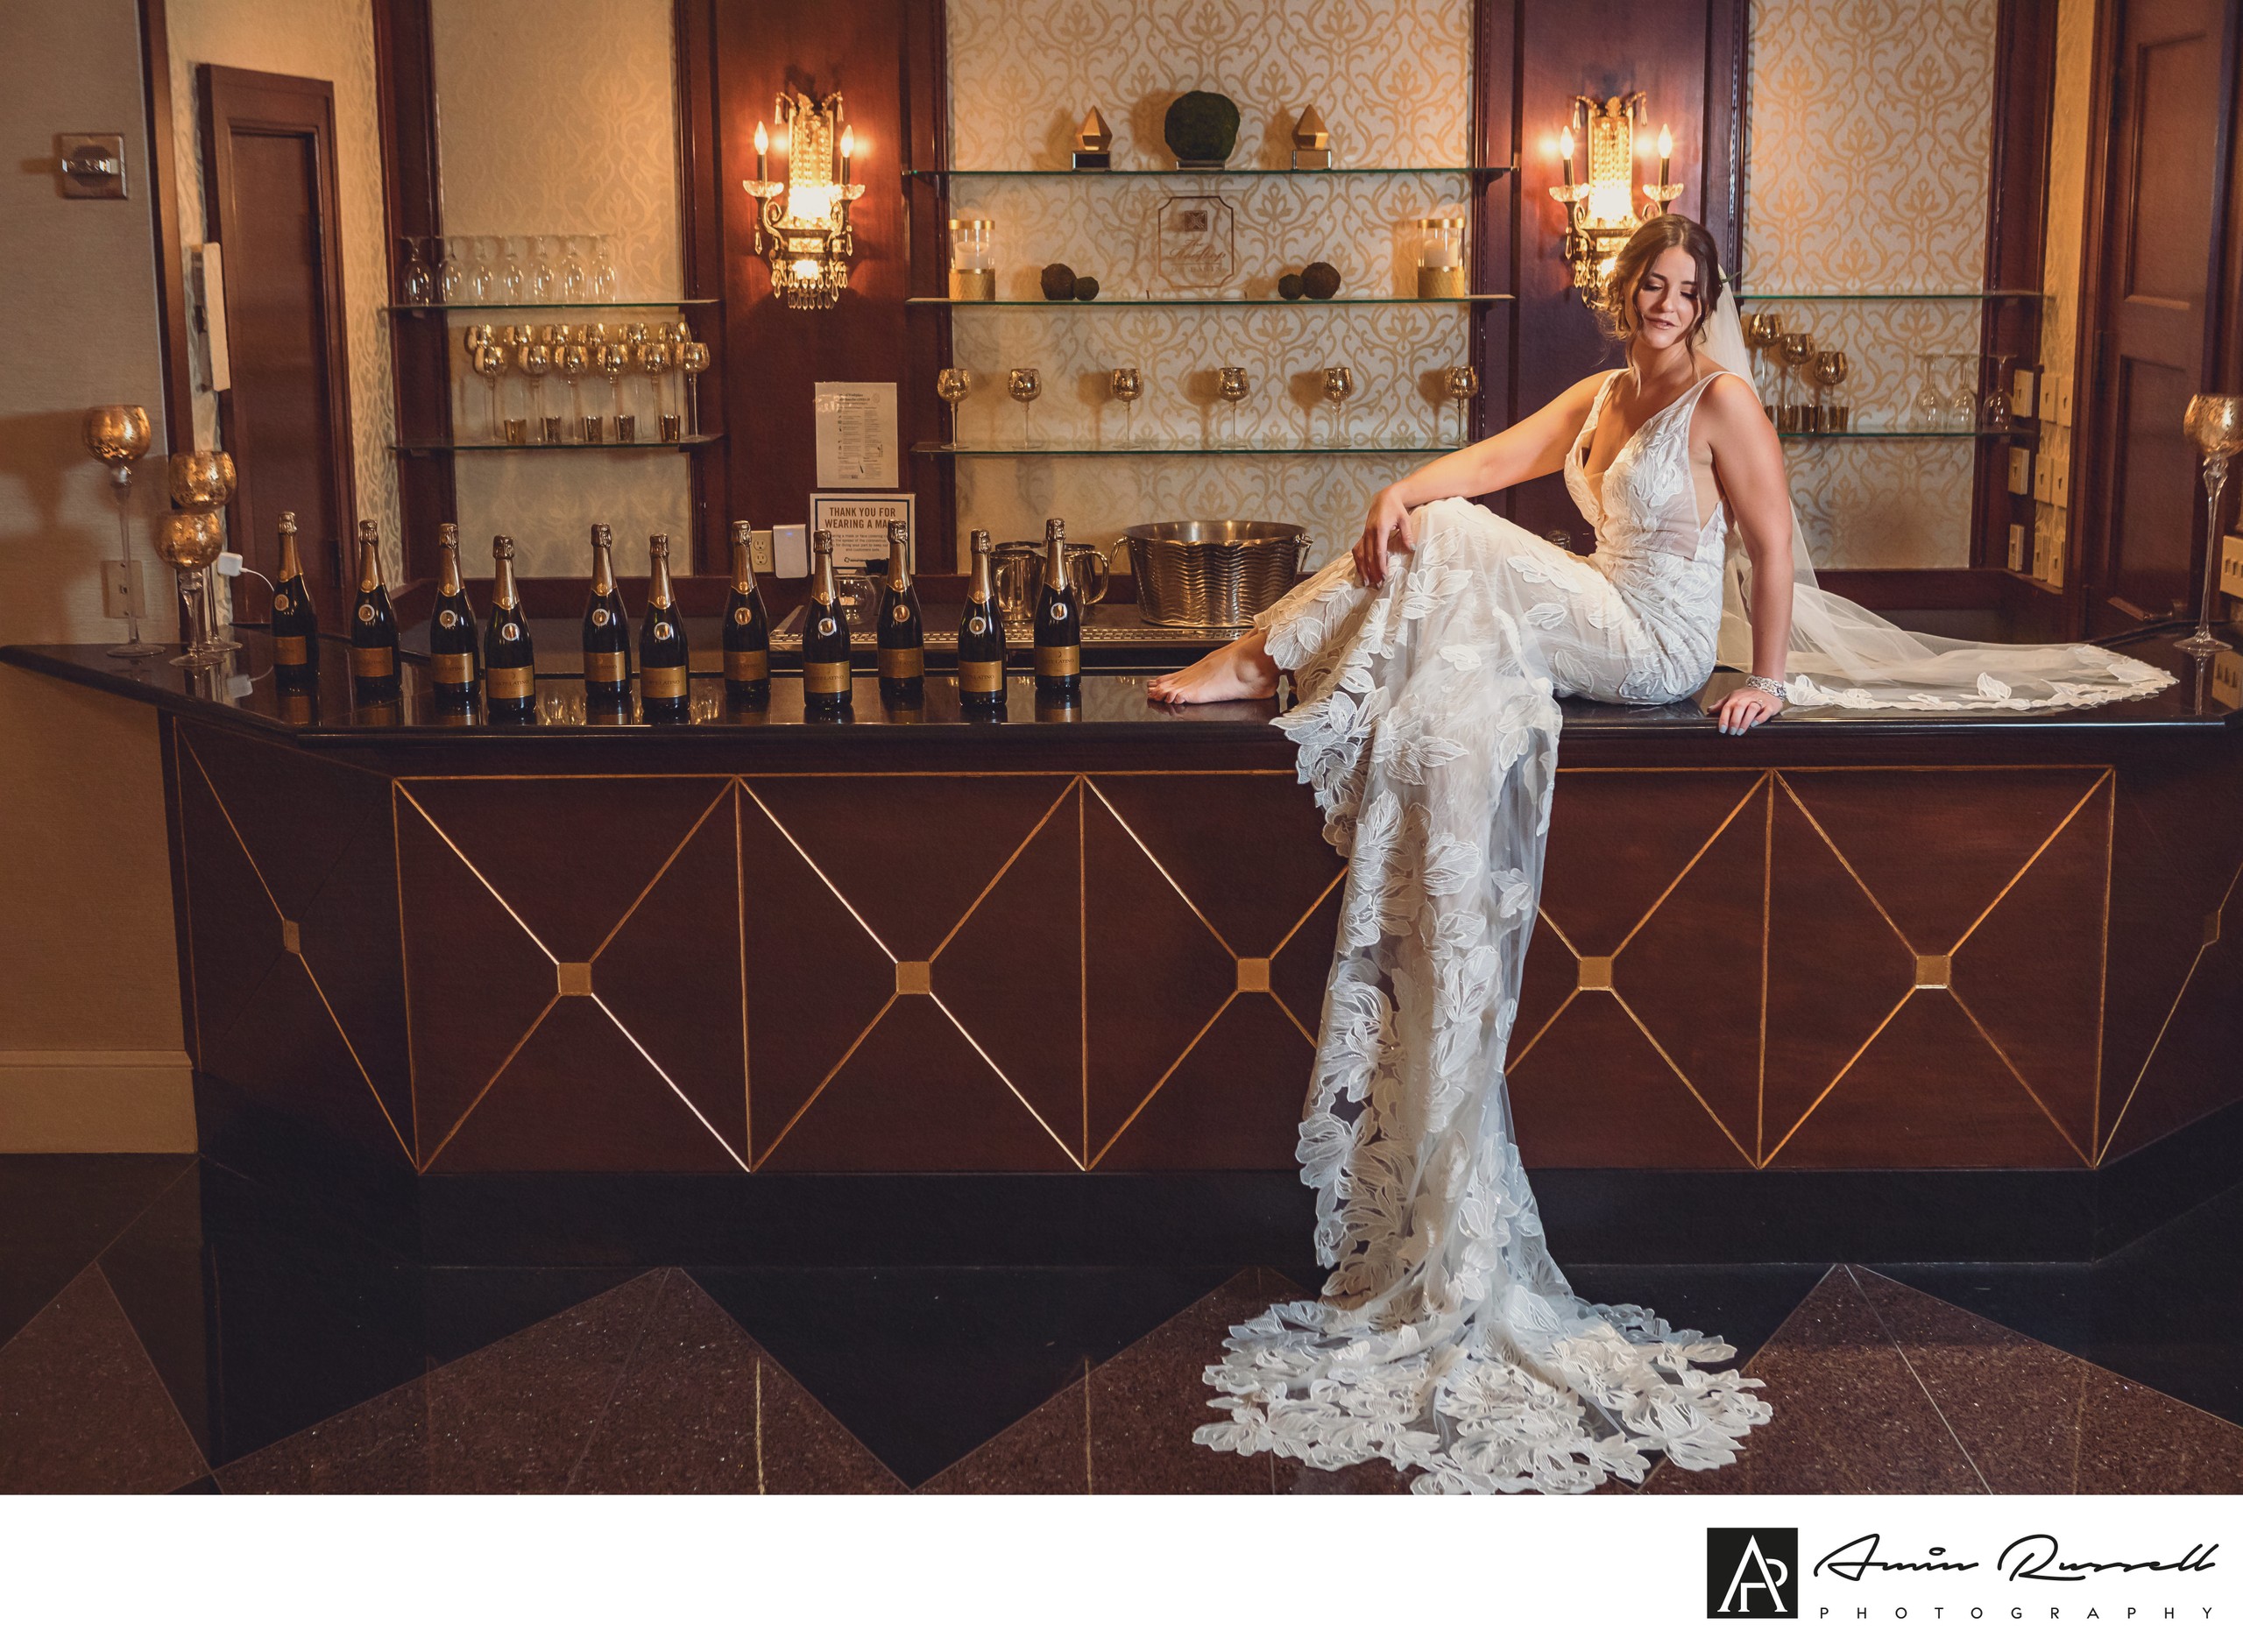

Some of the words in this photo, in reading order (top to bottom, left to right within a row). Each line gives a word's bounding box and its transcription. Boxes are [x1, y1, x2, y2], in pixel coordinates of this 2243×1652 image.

[830, 507, 857, 517] THANK
[859, 507, 876, 517] YOU
[879, 507, 896, 517] FOR
[824, 519, 864, 529] WEARING
[867, 519, 873, 529] A
[875, 519, 888, 529] MA
